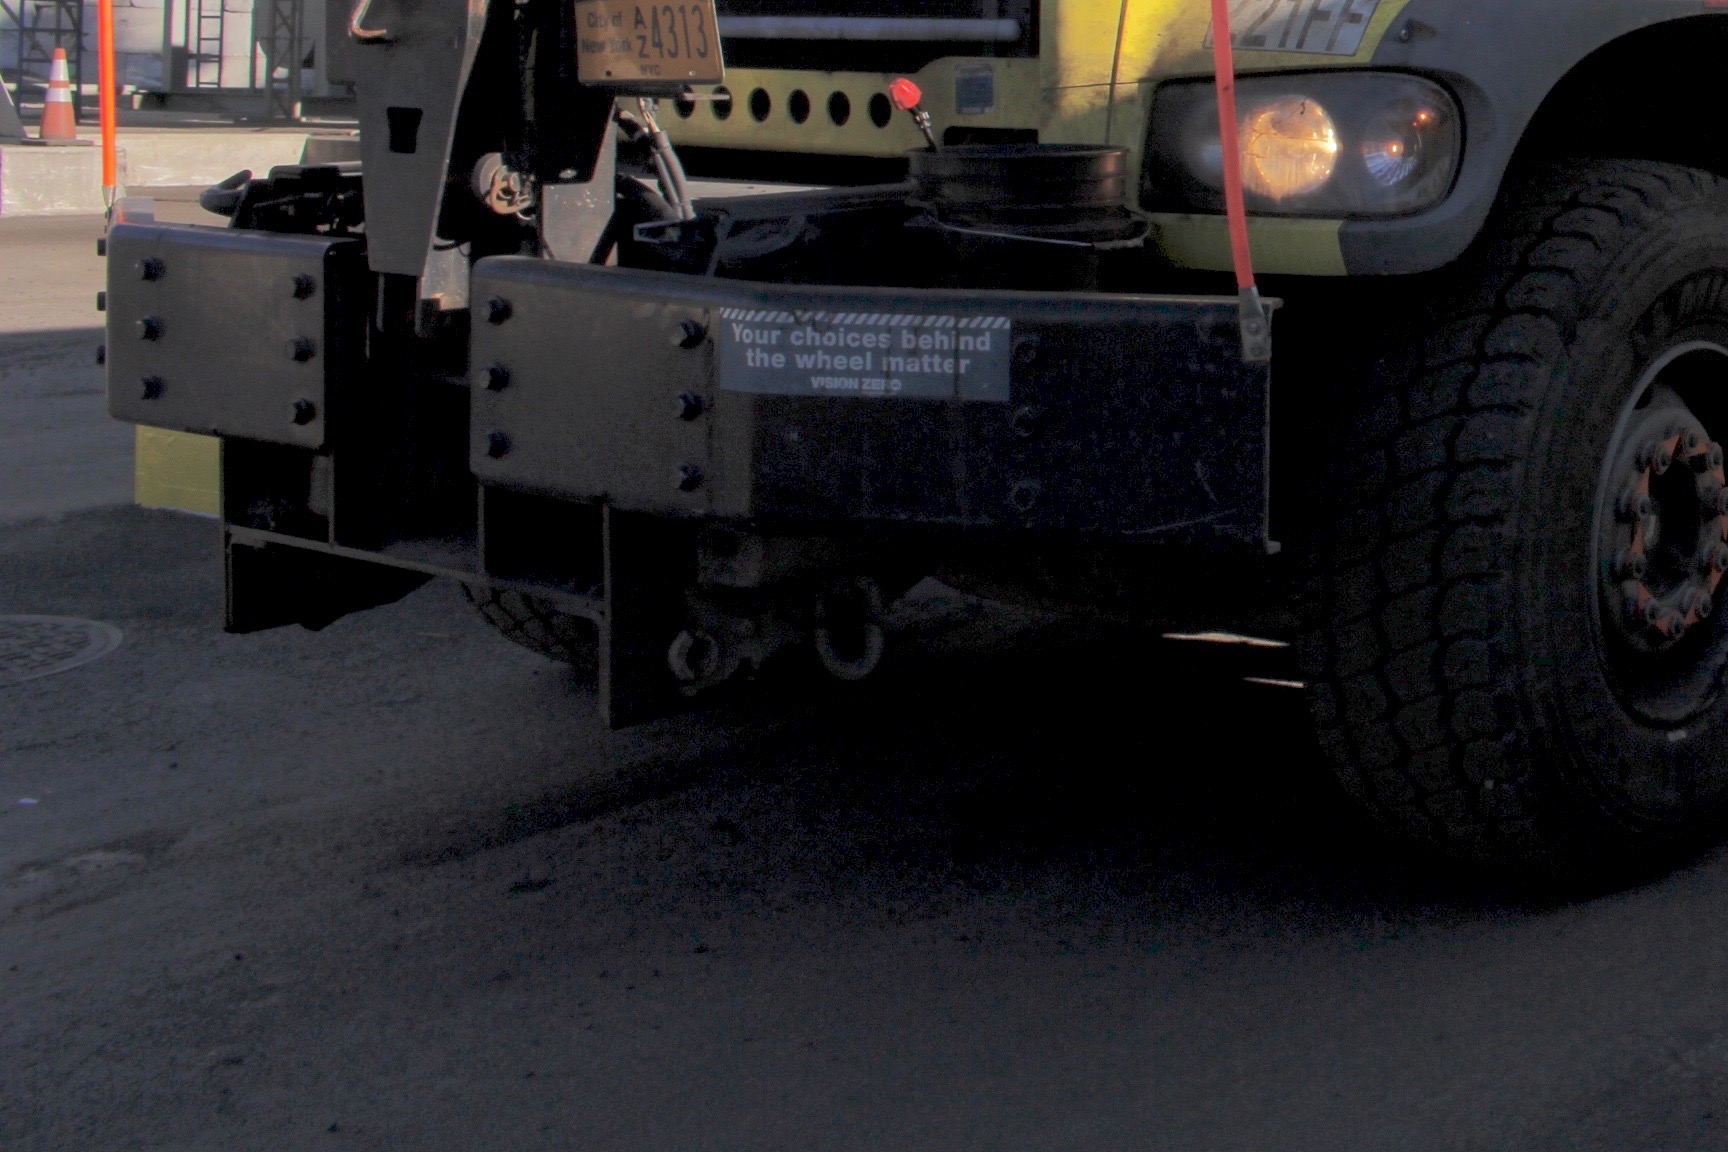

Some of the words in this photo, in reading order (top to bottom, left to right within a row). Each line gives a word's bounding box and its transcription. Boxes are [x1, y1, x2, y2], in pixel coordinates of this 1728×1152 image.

[634, 6, 646, 29] A
[652, 4, 708, 58] 4313
[636, 35, 649, 58] Z
[640, 64, 661, 75] NYC
[732, 323, 781, 345] Your
[790, 326, 891, 348] choices
[902, 329, 991, 350] behind
[746, 348, 785, 368] the
[796, 351, 872, 371] wheel
[882, 354, 971, 374] matter
[811, 376, 858, 390] VISION
